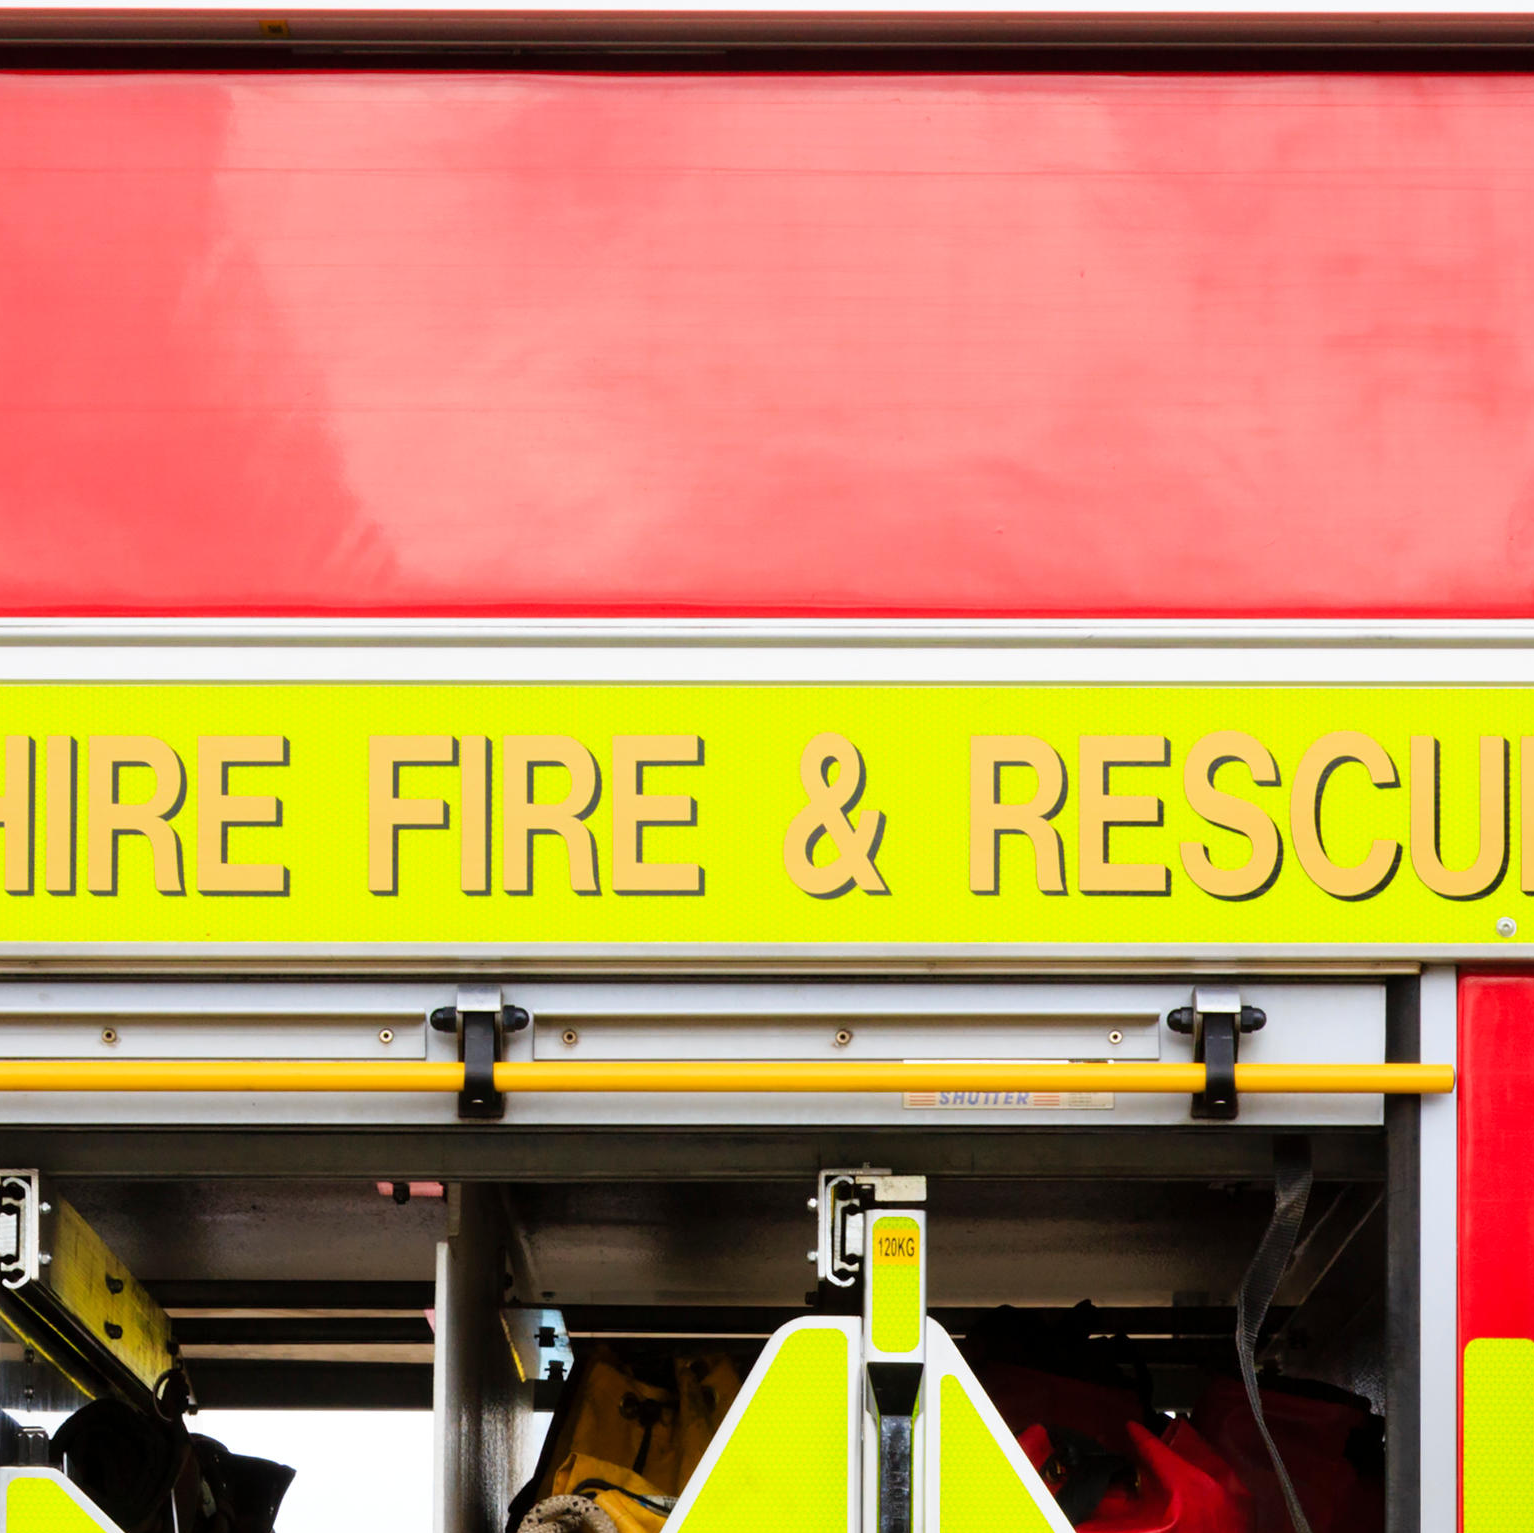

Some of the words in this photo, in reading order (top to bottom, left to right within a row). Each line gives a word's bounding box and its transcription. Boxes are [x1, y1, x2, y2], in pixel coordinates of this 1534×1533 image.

[366, 734, 705, 897] FIRE
[781, 731, 893, 900] &
[878, 1237, 916, 1258] 120KG
